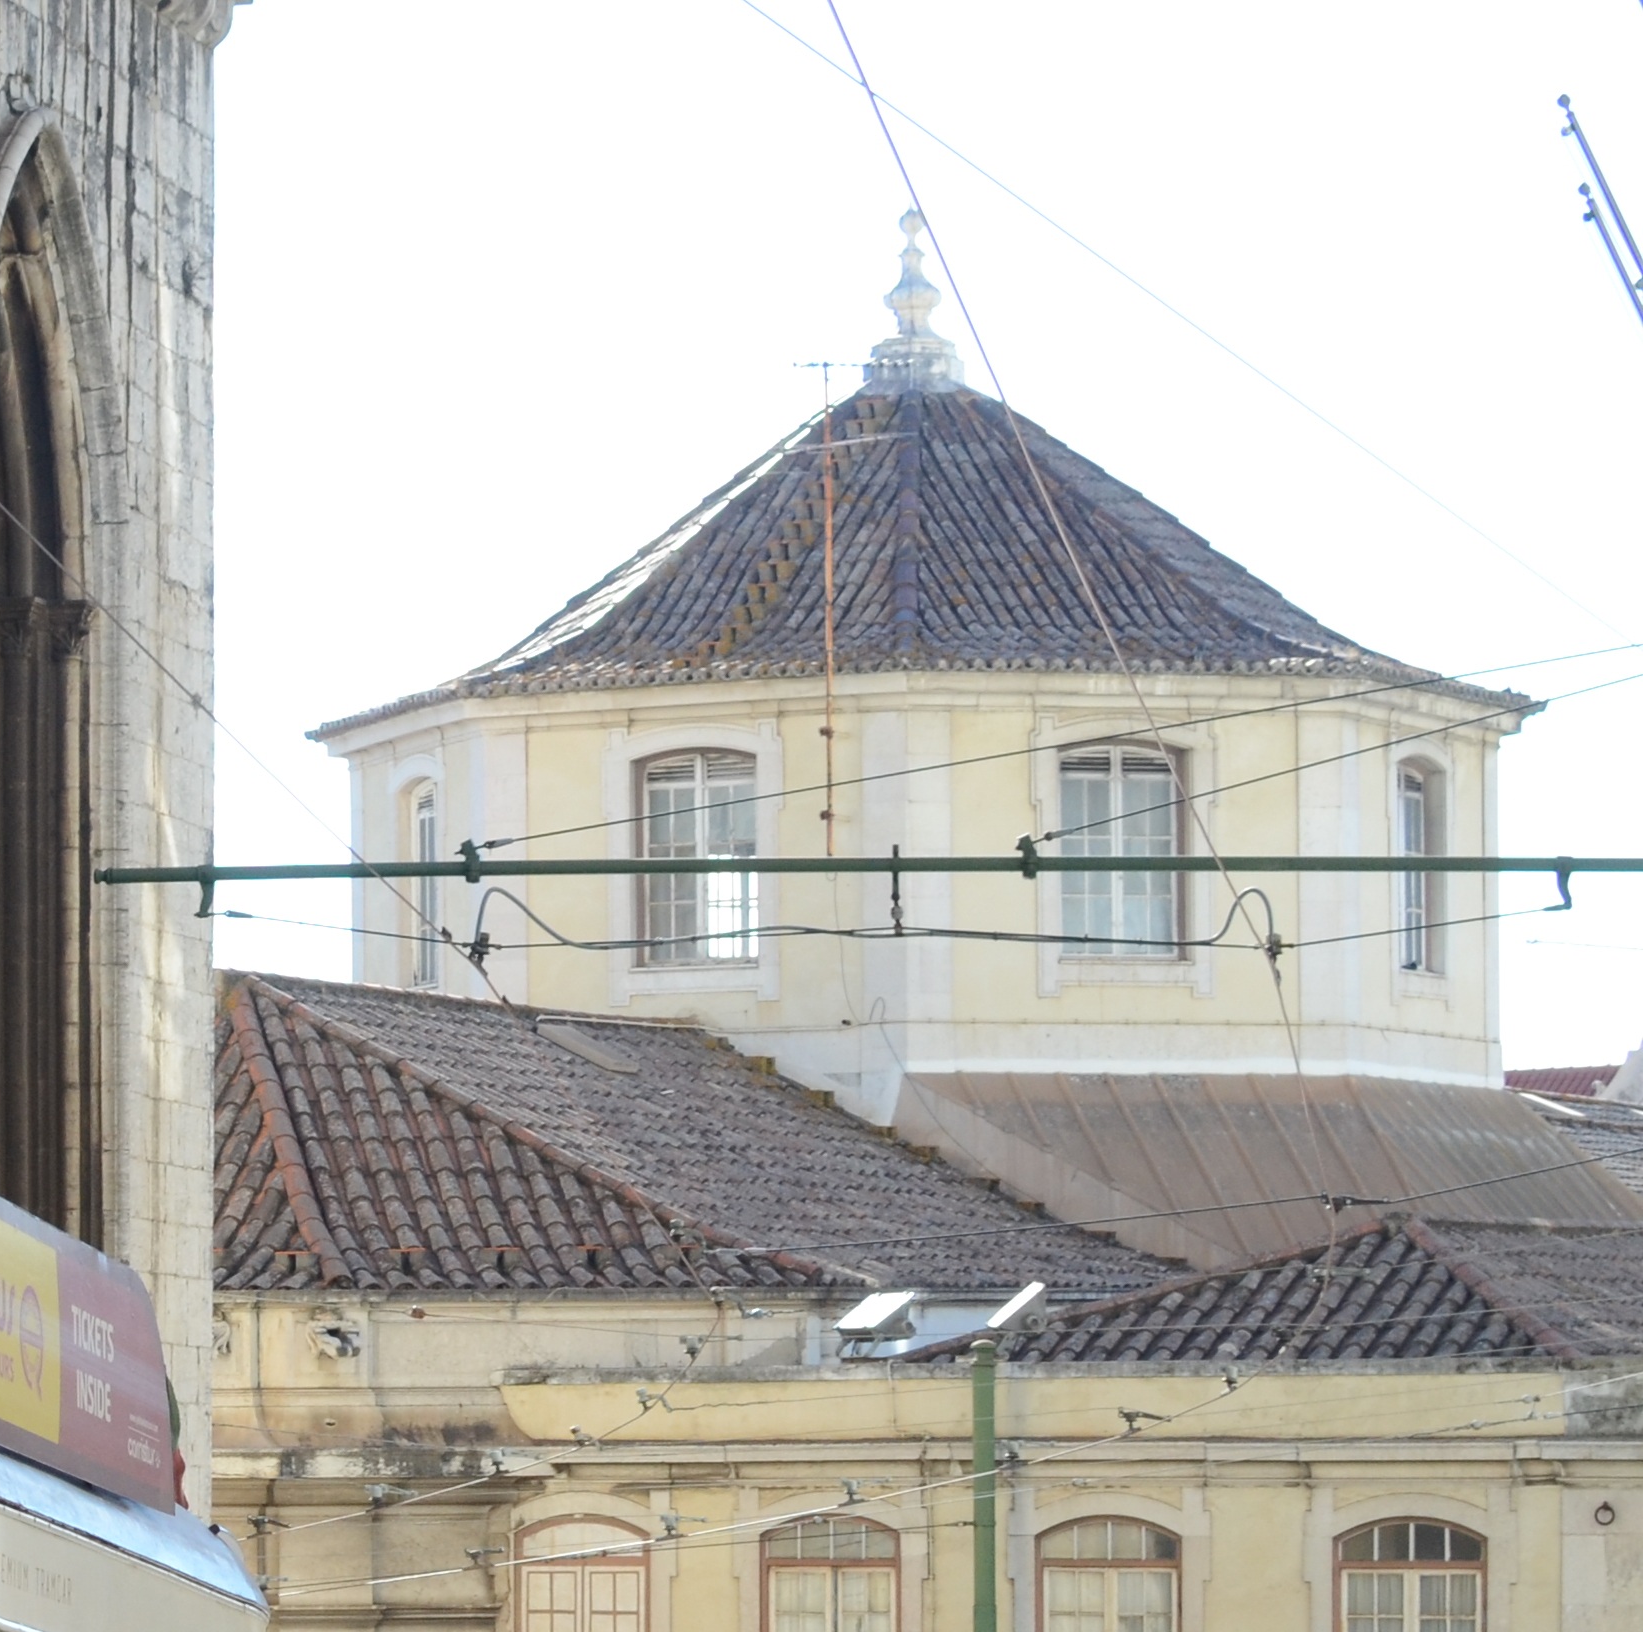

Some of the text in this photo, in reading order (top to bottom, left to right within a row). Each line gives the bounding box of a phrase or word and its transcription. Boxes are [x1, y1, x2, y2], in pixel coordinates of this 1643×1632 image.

[71, 1304, 115, 1363] TICKETS
[76, 1369, 112, 1423] INSIDE
[35, 1566, 72, 1606] TRAMCAR
